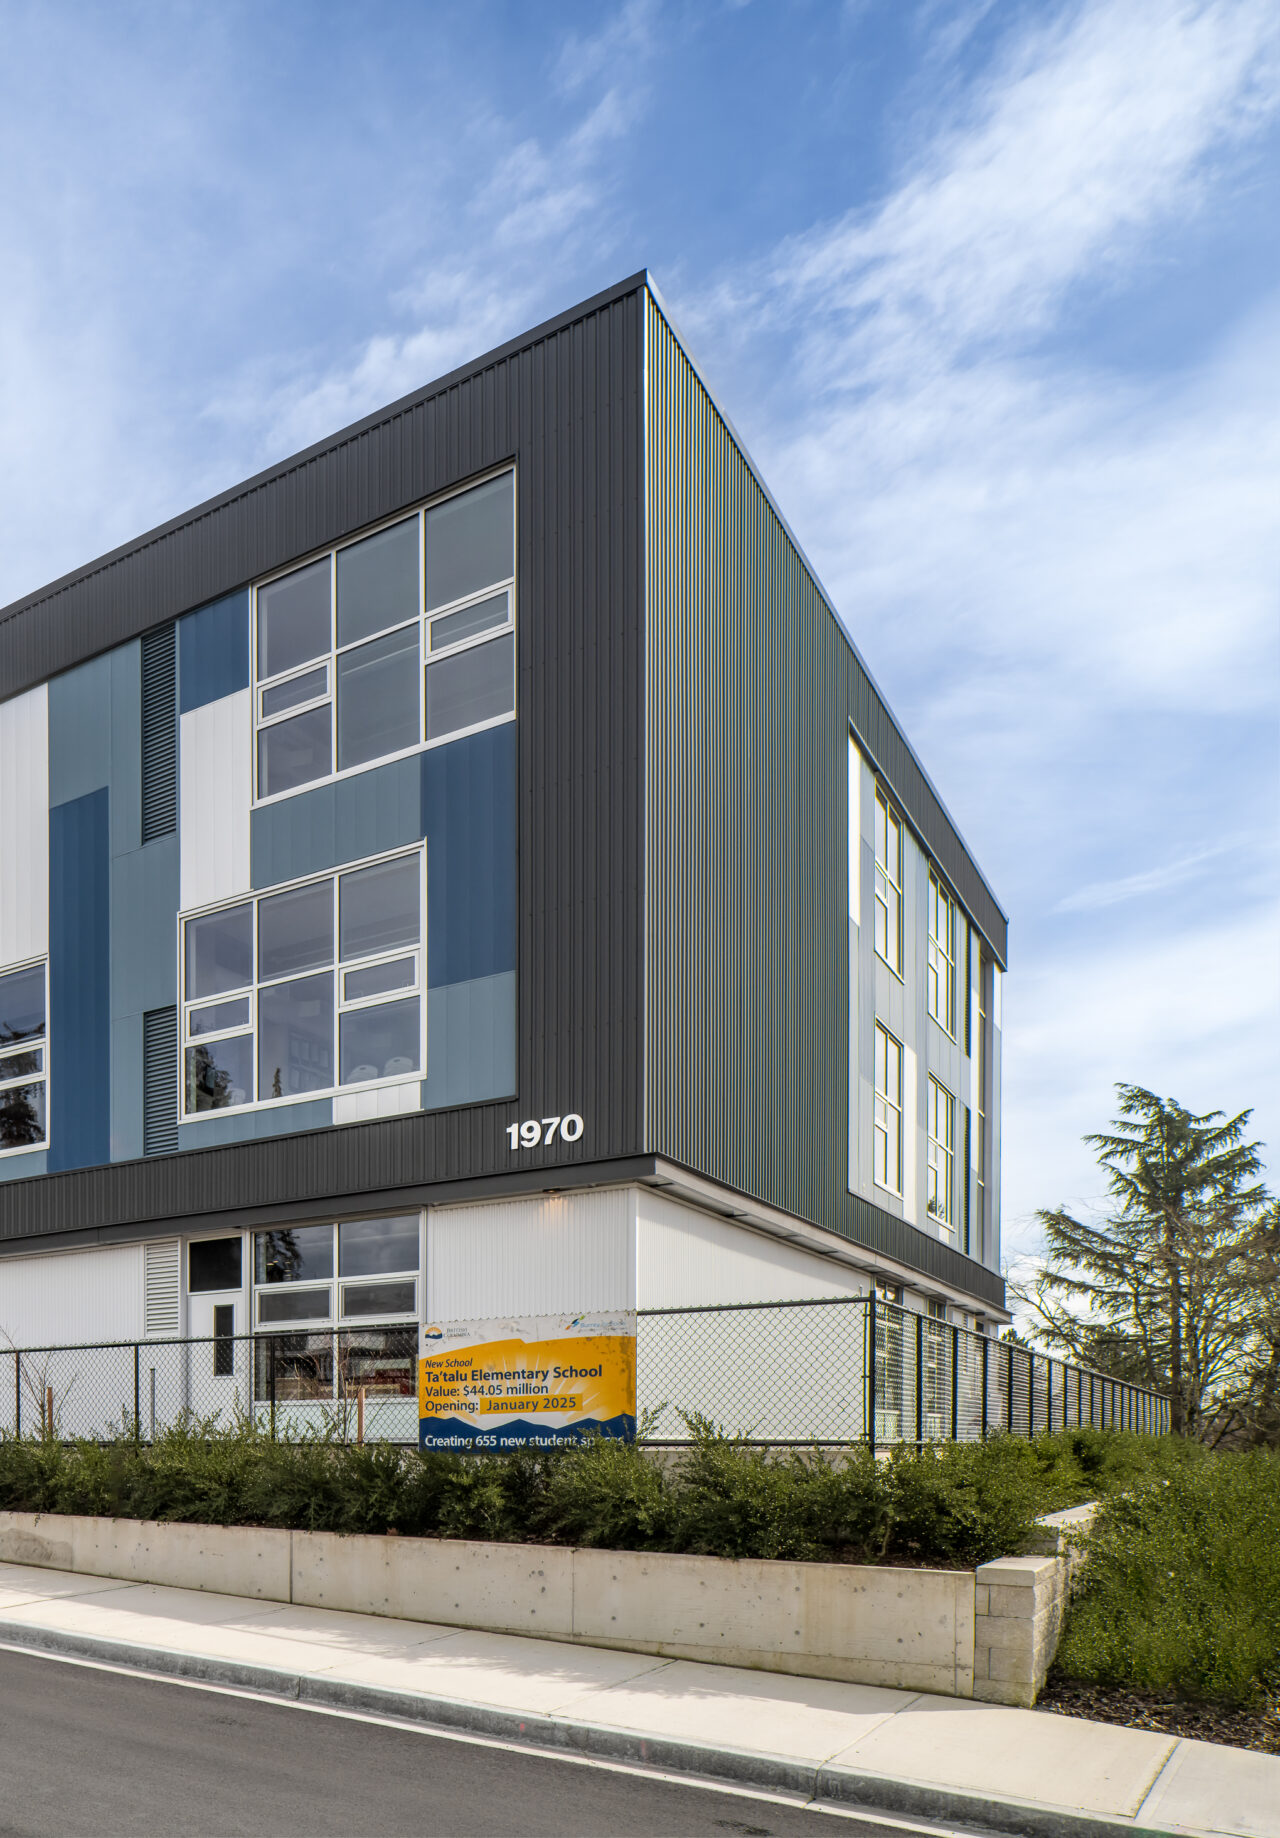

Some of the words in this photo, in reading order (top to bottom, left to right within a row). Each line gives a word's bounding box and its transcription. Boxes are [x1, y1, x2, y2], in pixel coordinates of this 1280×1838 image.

[506, 1113, 584, 1150] 1970
[425, 1360, 444, 1368] New
[445, 1357, 473, 1368] School
[471, 1369, 550, 1382] Elementary
[553, 1364, 602, 1379] School
[425, 1386, 460, 1397] Value:
[463, 1384, 503, 1397] $44.05
[506, 1383, 549, 1395] million
[425, 1400, 479, 1414] Opening:
[486, 1400, 539, 1412] January
[543, 1397, 576, 1409] 2025
[425, 1435, 472, 1449] Creating
[475, 1435, 497, 1446] 655
[500, 1437, 526, 1446] new
[529, 1434, 578, 1446] student
